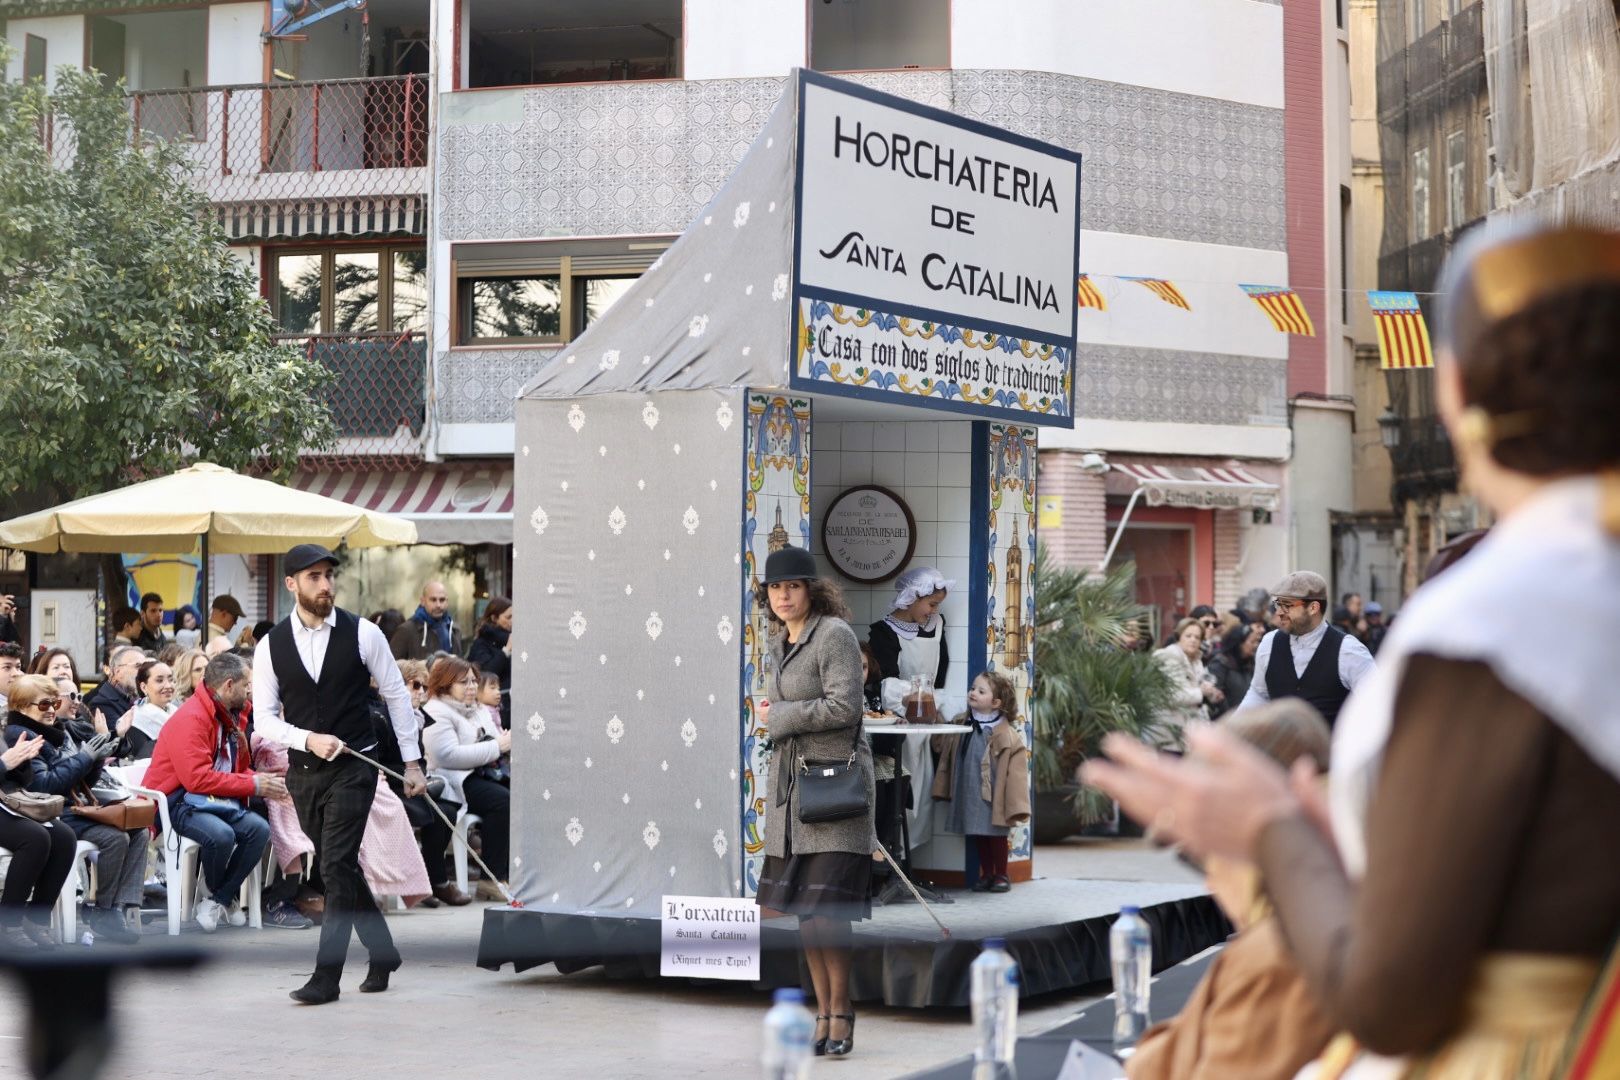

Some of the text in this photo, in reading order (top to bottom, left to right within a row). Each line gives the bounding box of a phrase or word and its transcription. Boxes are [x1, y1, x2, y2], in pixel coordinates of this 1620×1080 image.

[834, 115, 1059, 214] HORCHATERIA
[931, 204, 976, 236] DE
[819, 231, 1060, 314] SANTA CATALINA
[818, 324, 1059, 396] Casa con dos siglos de tradición
[667, 902, 756, 923] L'orxateria
[675, 928, 747, 941] Santa Catalina
